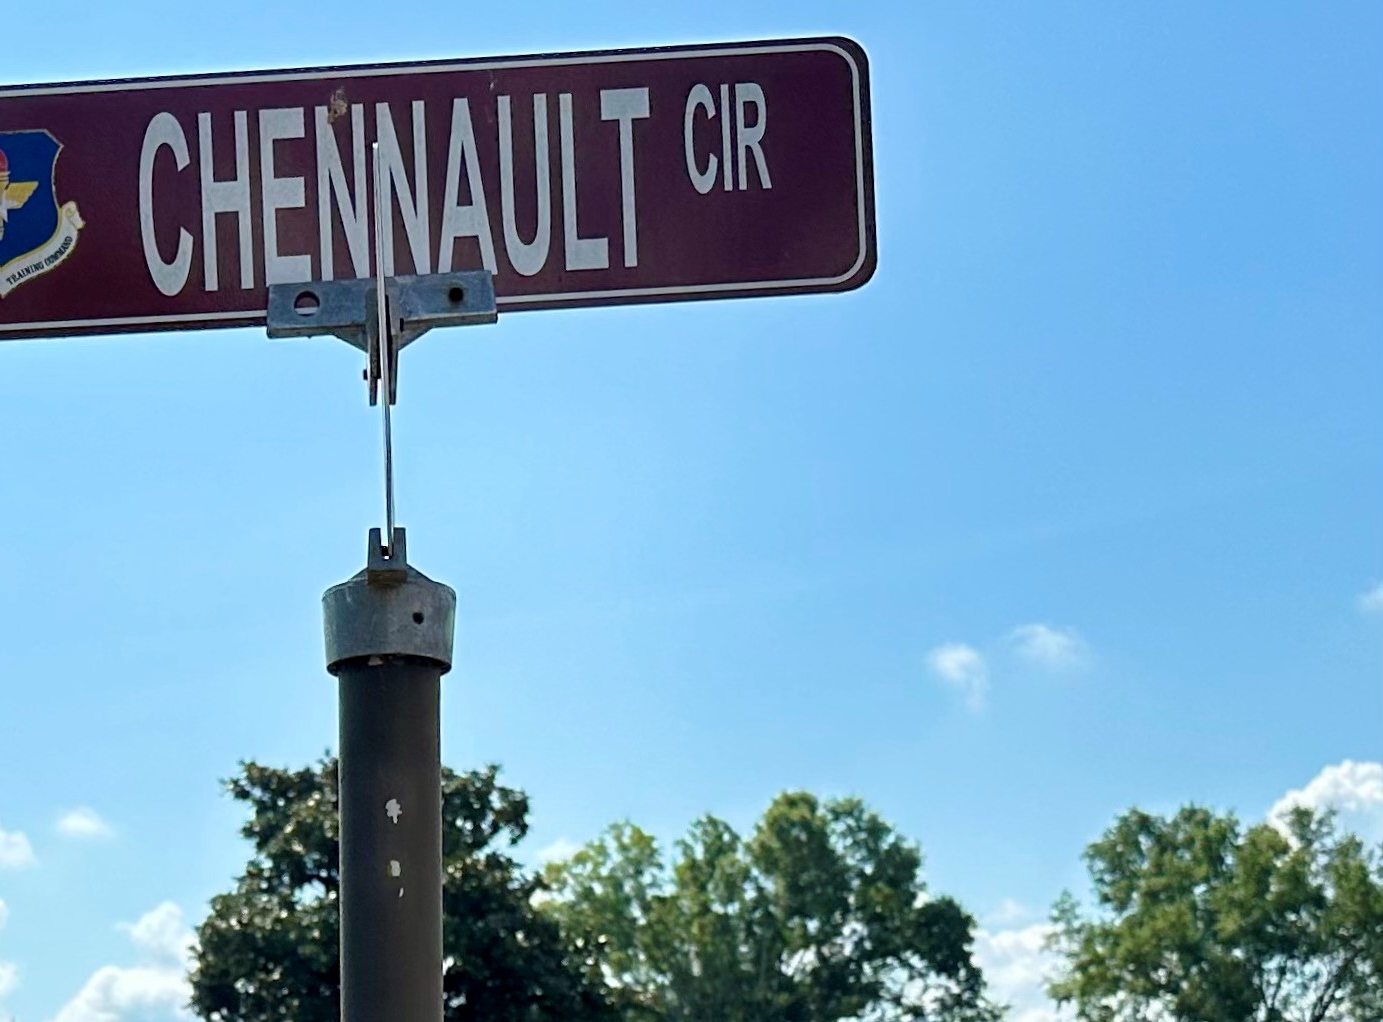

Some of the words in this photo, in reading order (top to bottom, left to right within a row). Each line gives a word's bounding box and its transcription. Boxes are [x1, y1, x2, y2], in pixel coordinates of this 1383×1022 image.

[138, 86, 650, 297] CHENNAULT
[683, 82, 772, 195] CIR
[6, 261, 45, 285] TRAINING
[44, 235, 73, 267] COMMAND
